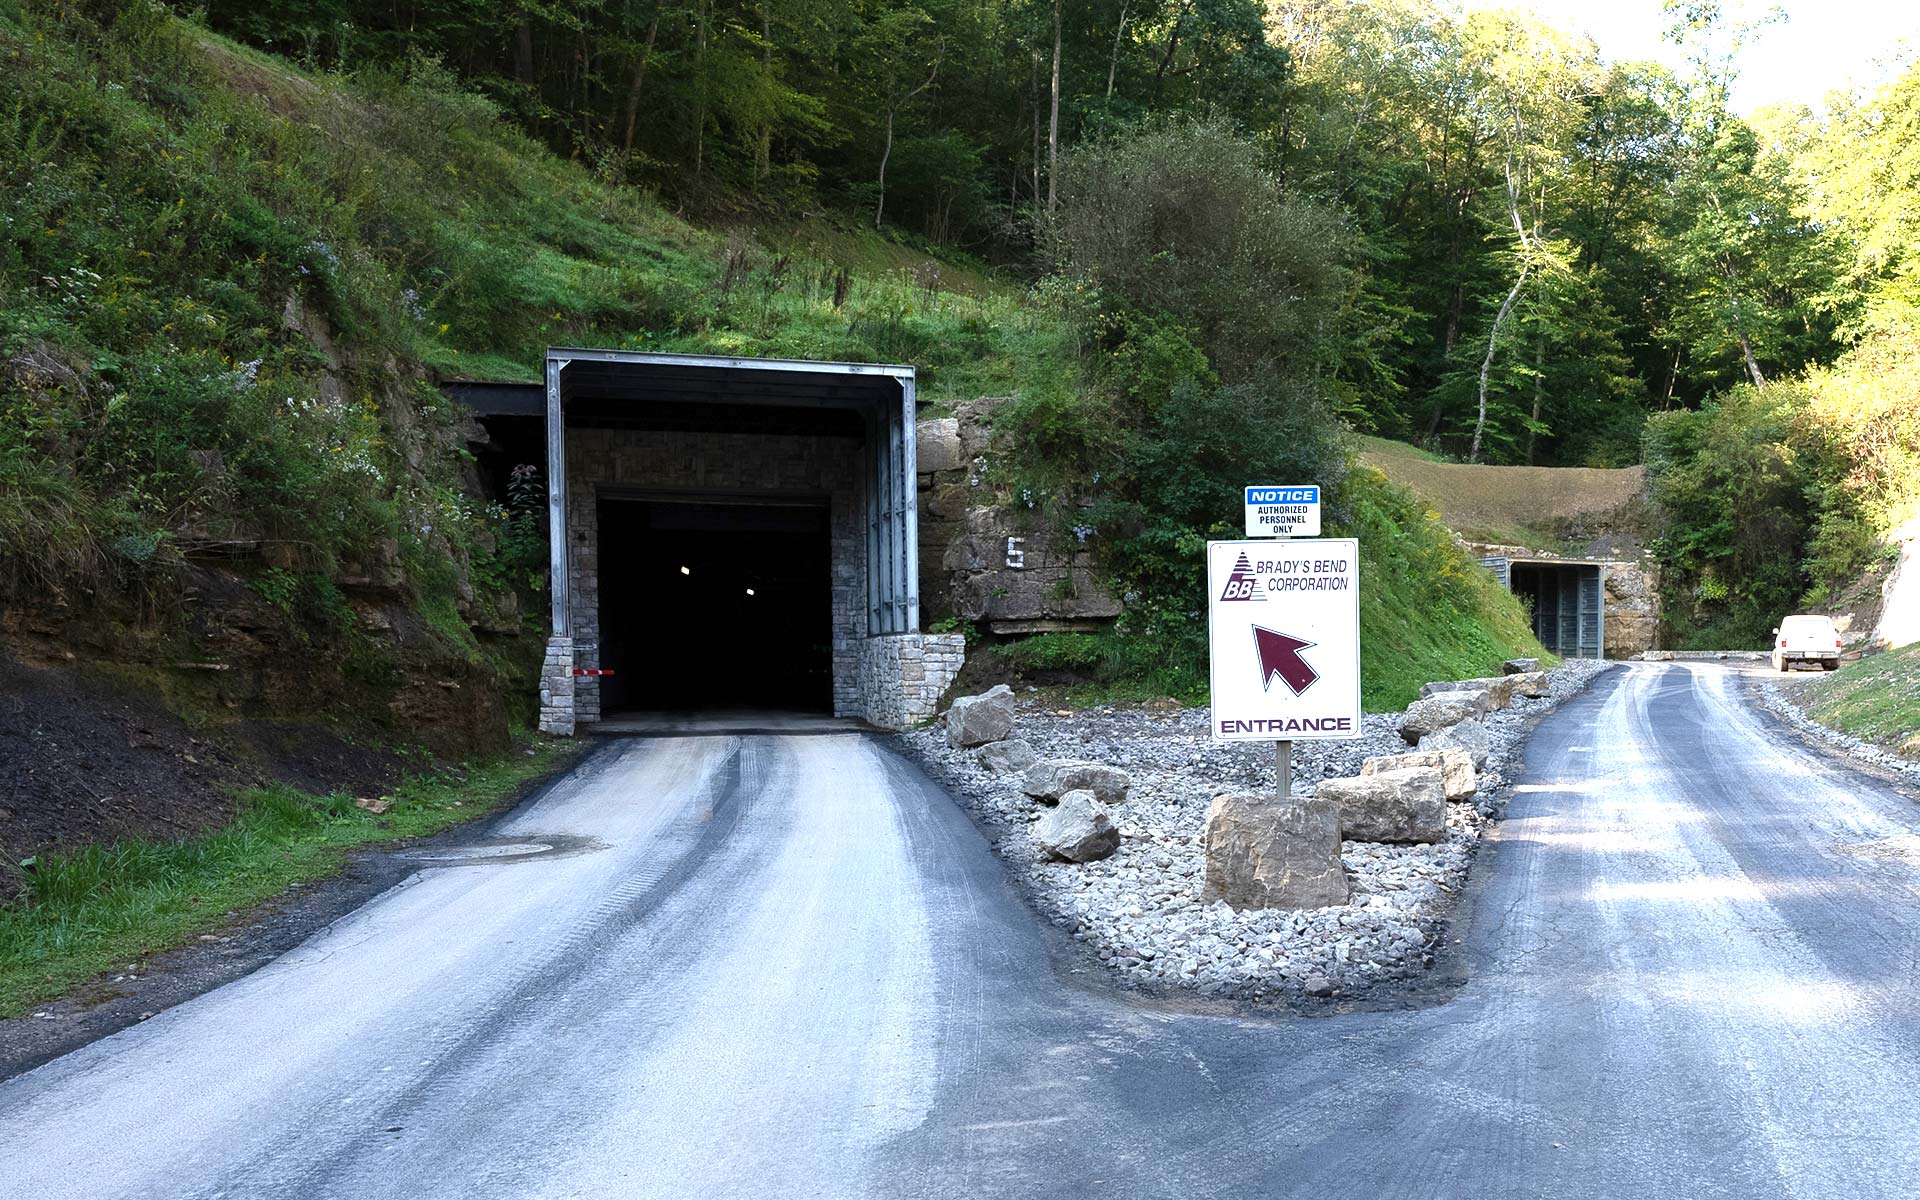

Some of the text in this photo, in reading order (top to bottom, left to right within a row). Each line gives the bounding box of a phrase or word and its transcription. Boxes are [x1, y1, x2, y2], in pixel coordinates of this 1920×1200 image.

[1252, 491, 1313, 501] NOTICE
[1258, 506, 1308, 514] AUTHORIZED
[1260, 516, 1306, 524] PERSONNEL
[1273, 525, 1293, 534] ONLY
[1256, 560, 1348, 574] BRADY'S BEND
[1225, 581, 1253, 599] BB
[1268, 577, 1348, 591] CORPORATION
[1221, 718, 1351, 733] ENTRANCE
